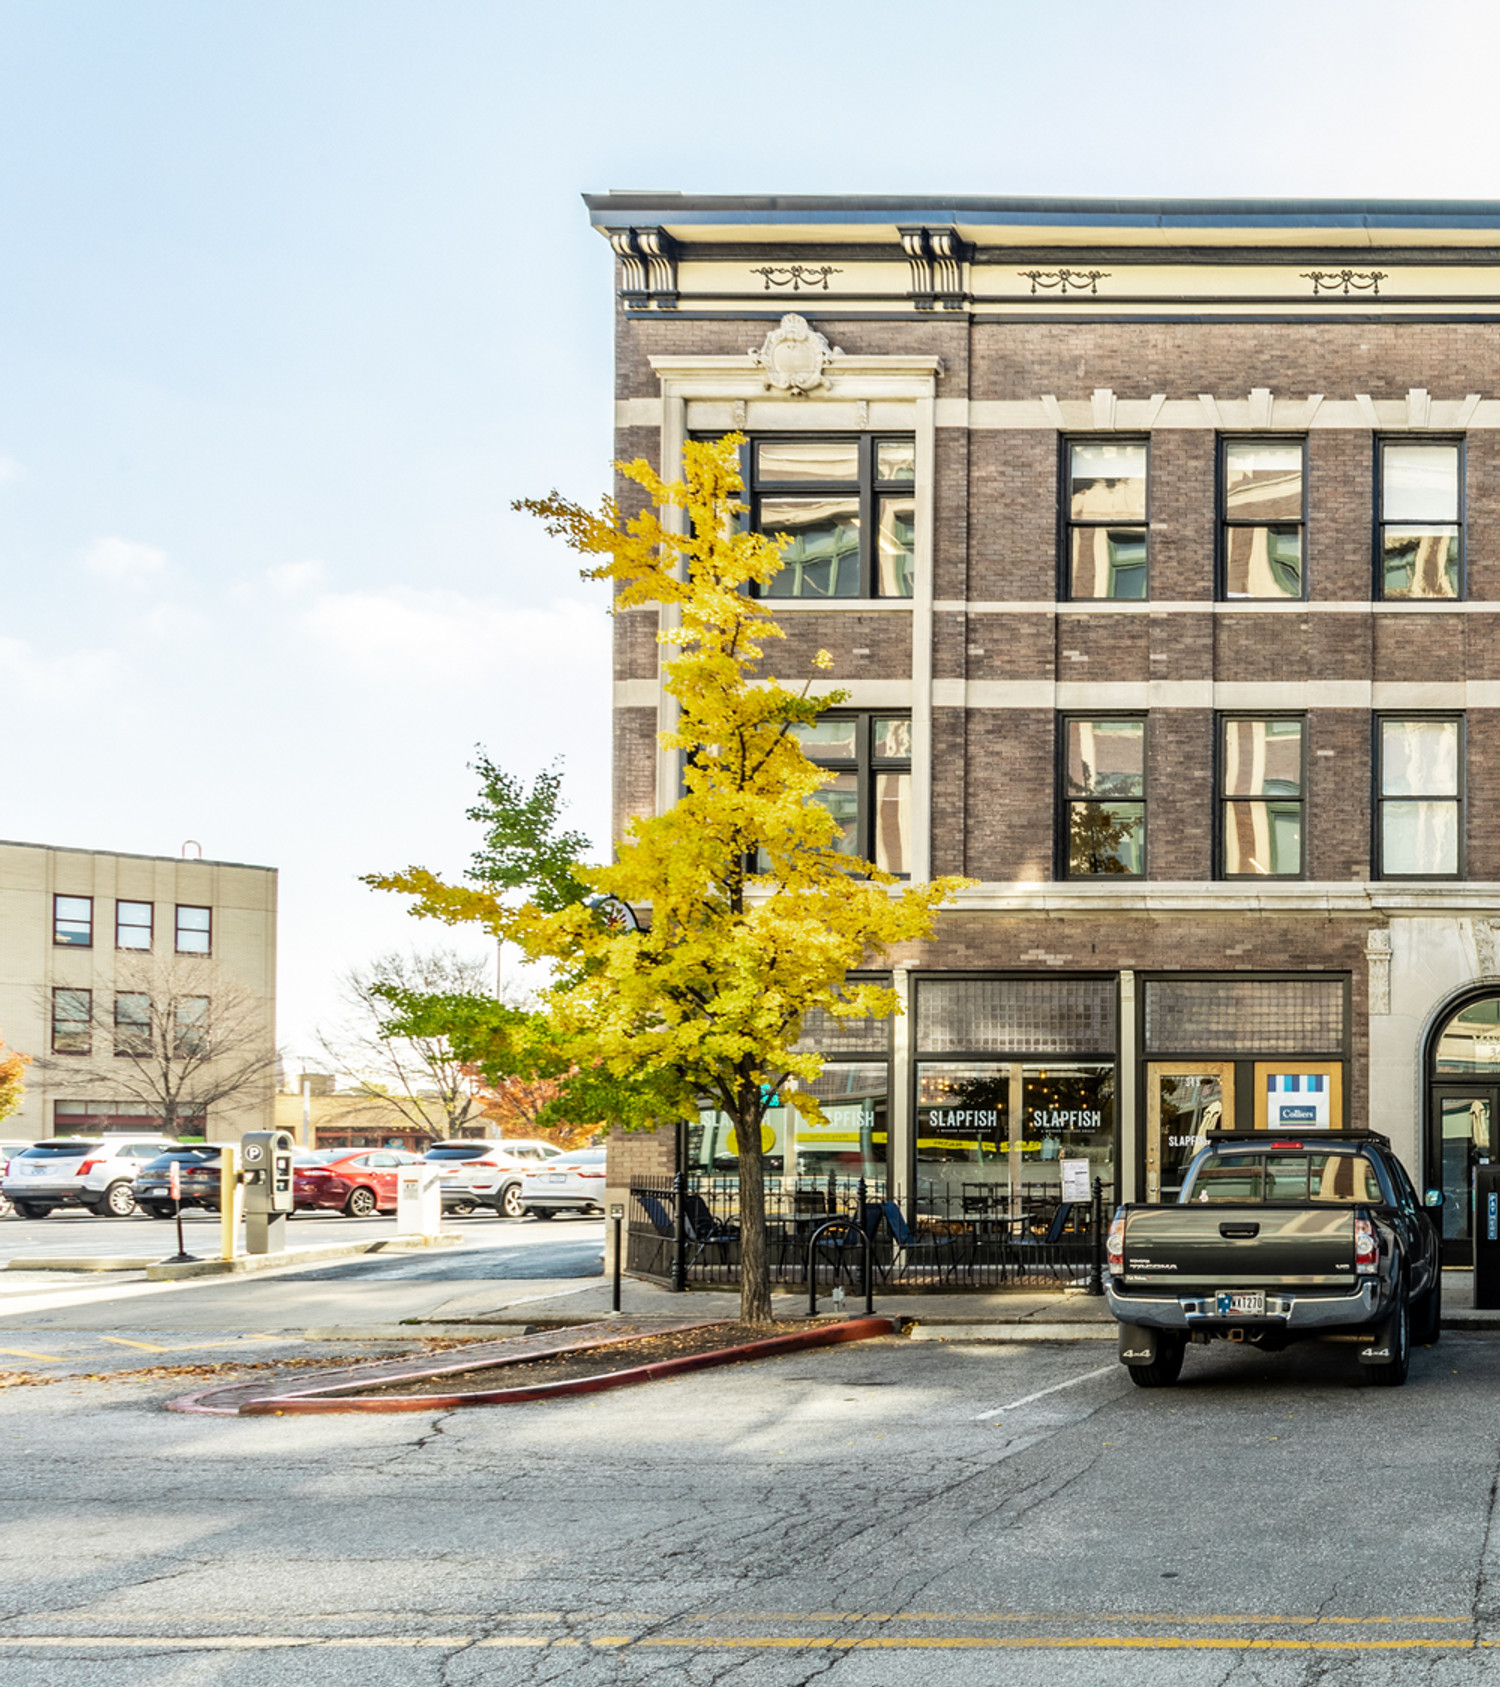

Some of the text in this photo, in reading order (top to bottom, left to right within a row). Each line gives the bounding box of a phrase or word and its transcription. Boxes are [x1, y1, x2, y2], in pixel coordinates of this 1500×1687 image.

[929, 1109, 998, 1127] SLAPFISH
[1033, 1110, 1101, 1127] SLAPFISH
[1282, 1108, 1314, 1119] Colliers
